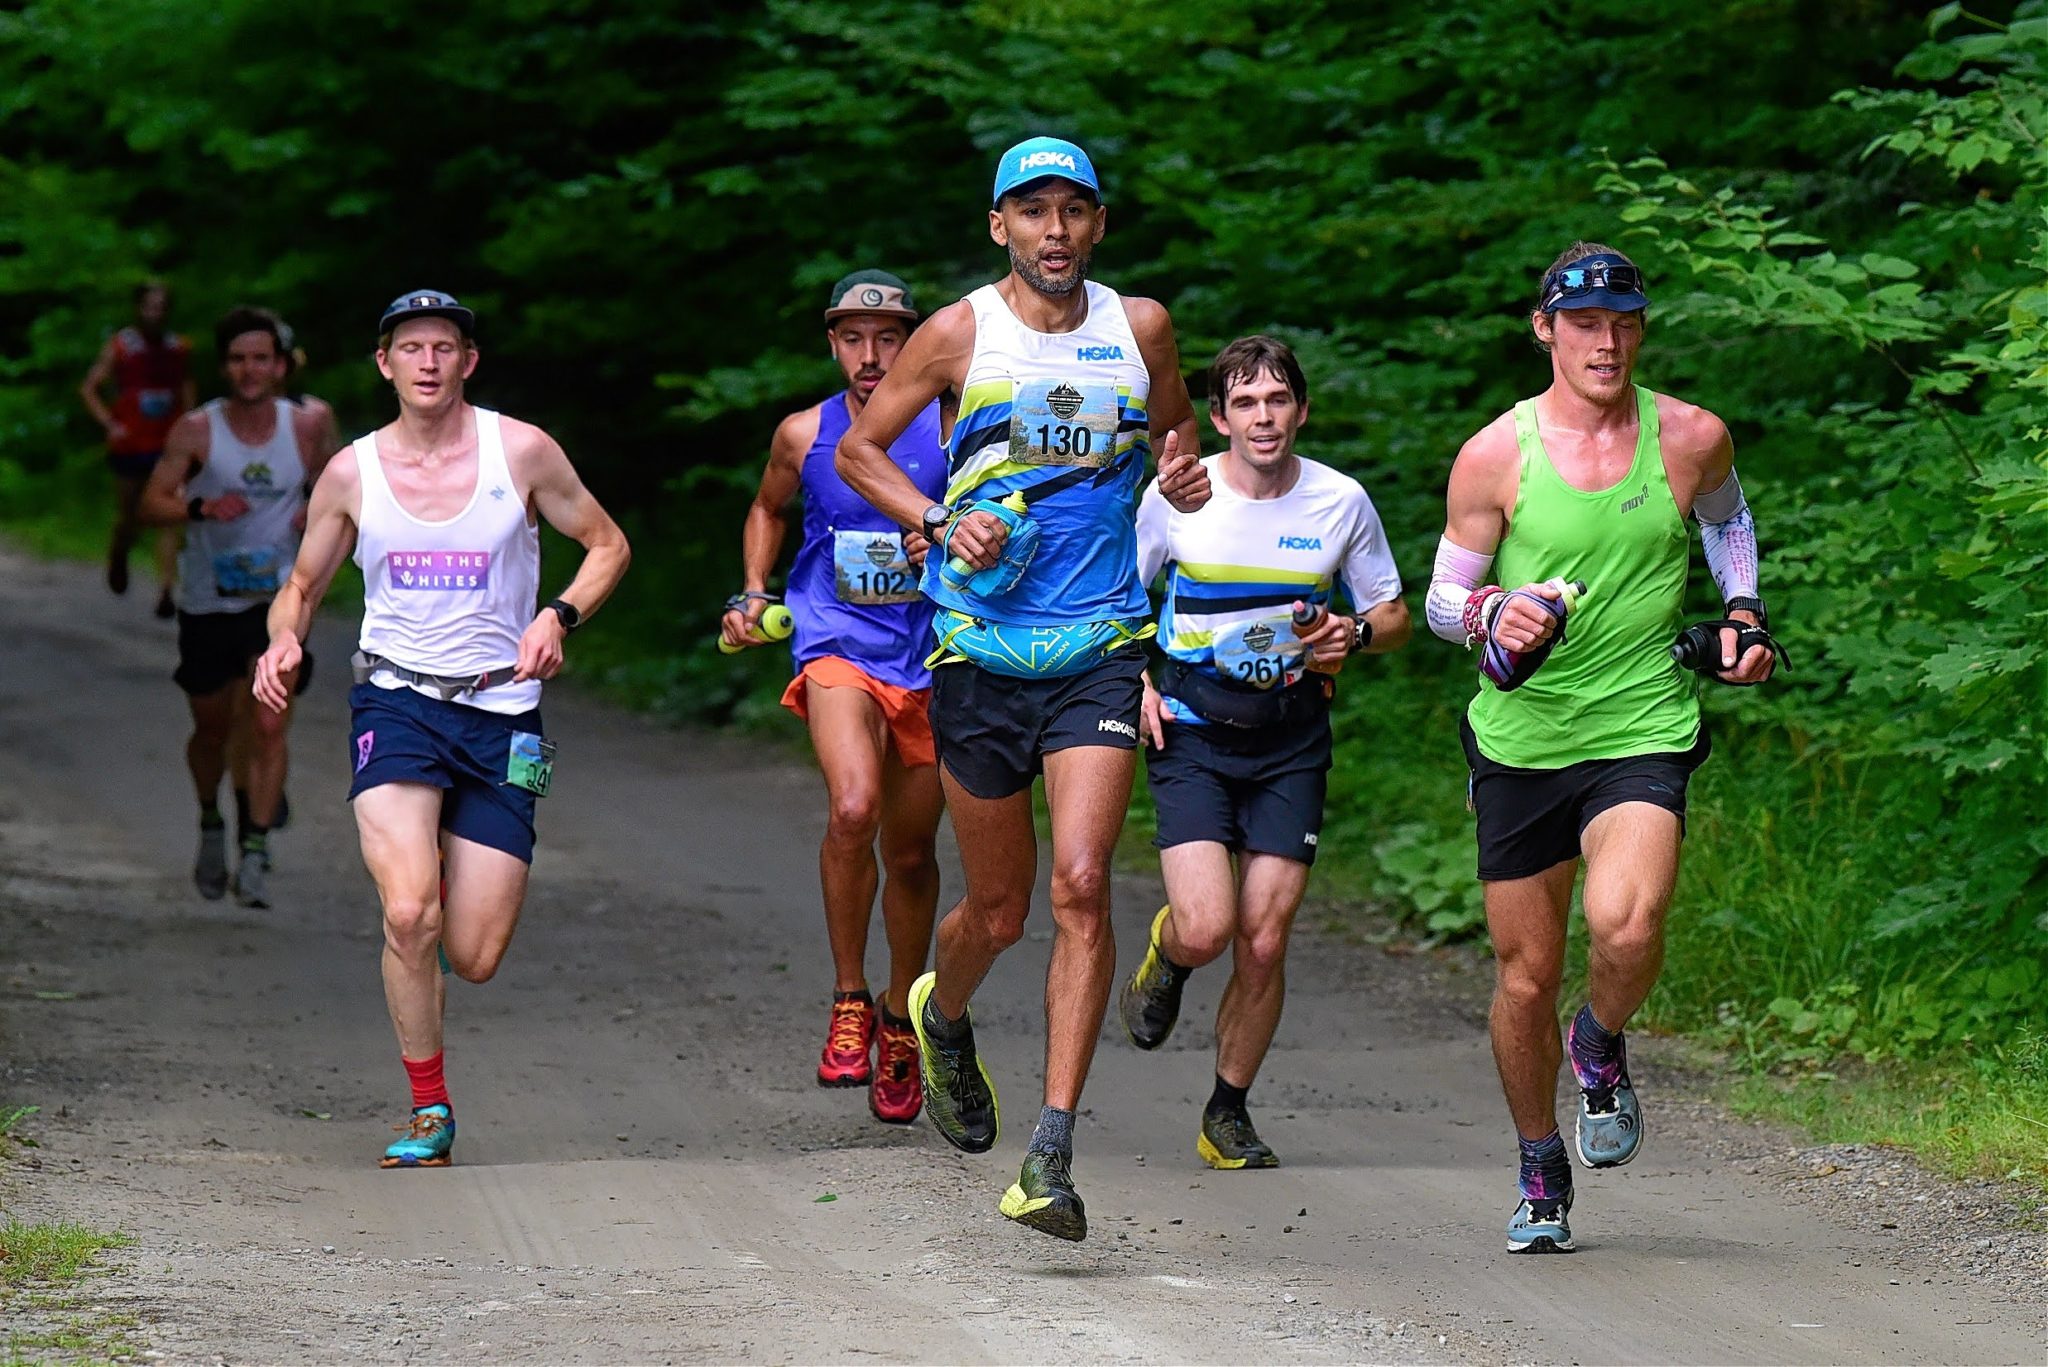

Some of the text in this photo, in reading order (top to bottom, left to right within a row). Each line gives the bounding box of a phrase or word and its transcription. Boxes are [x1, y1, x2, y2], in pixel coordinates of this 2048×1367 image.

[1020, 151, 1076, 173] HOKA
[1077, 346, 1124, 361] HOKA
[1037, 424, 1092, 457] 130
[1278, 536, 1322, 550] HOKA
[393, 555, 483, 567] RUN THE
[400, 571, 477, 587] WHITES
[857, 571, 907, 596] 102
[1038, 640, 1070, 672] NATHAN
[1238, 655, 1284, 684] 261
